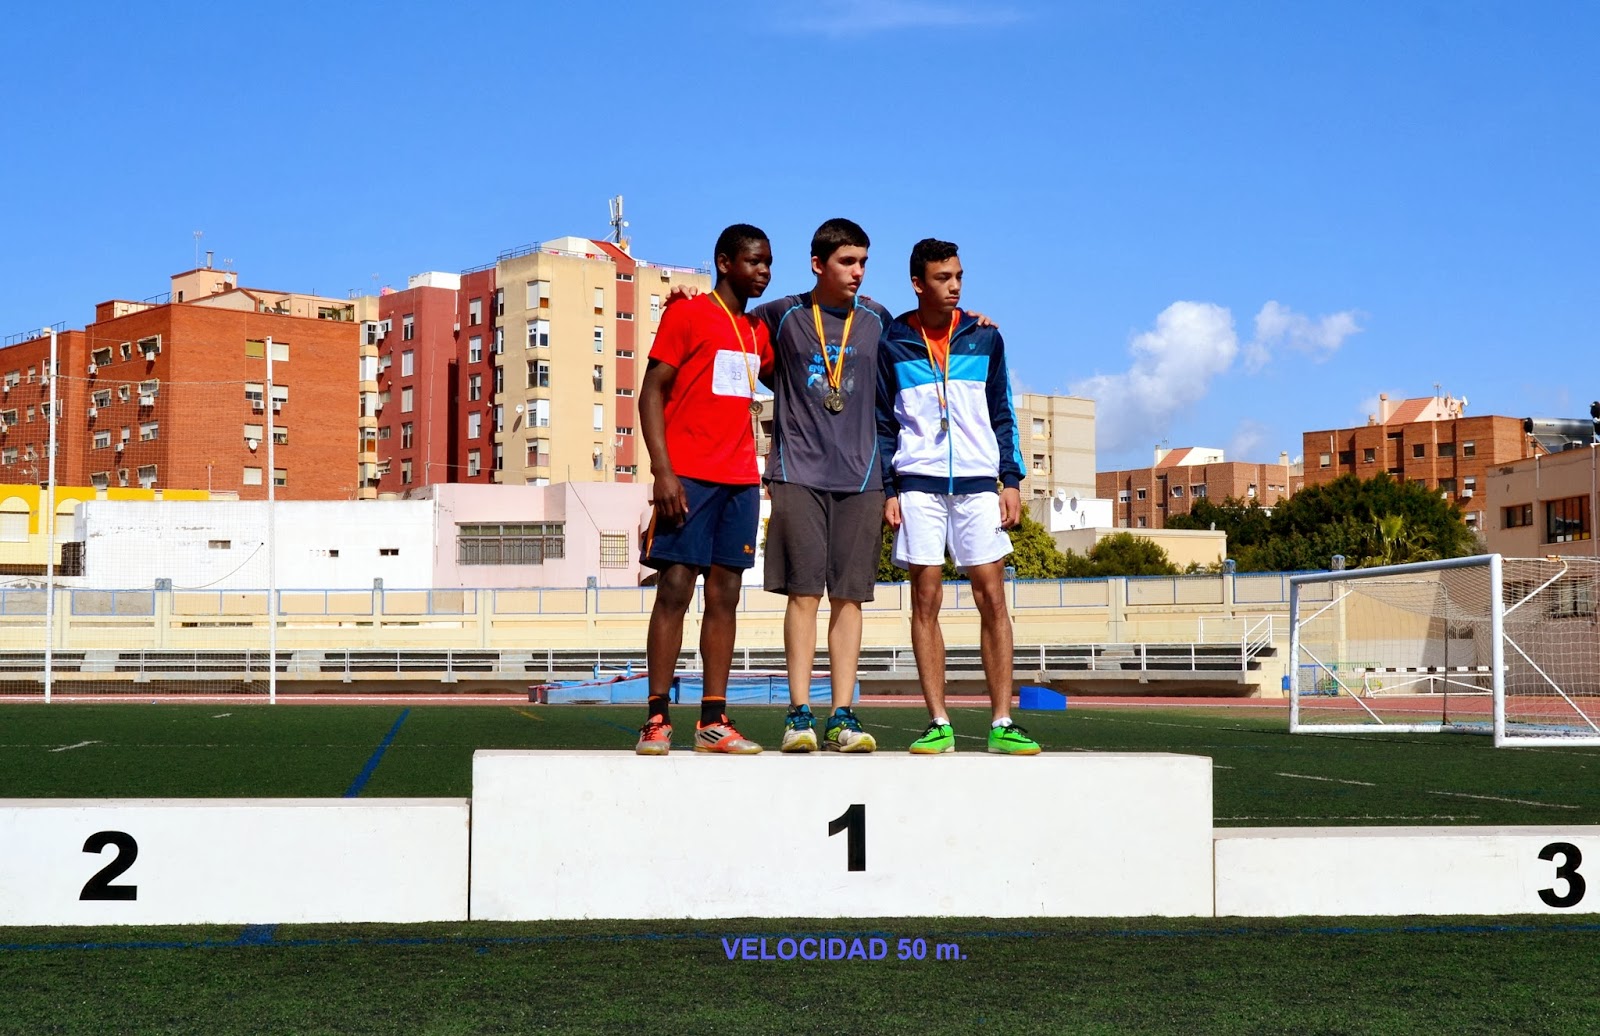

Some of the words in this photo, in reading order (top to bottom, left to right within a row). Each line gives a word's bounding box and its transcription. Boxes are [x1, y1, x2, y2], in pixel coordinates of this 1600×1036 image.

[731, 370, 742, 381] 23
[79, 830, 138, 901] 2
[829, 804, 866, 872] 1
[1537, 842, 1587, 908] 3
